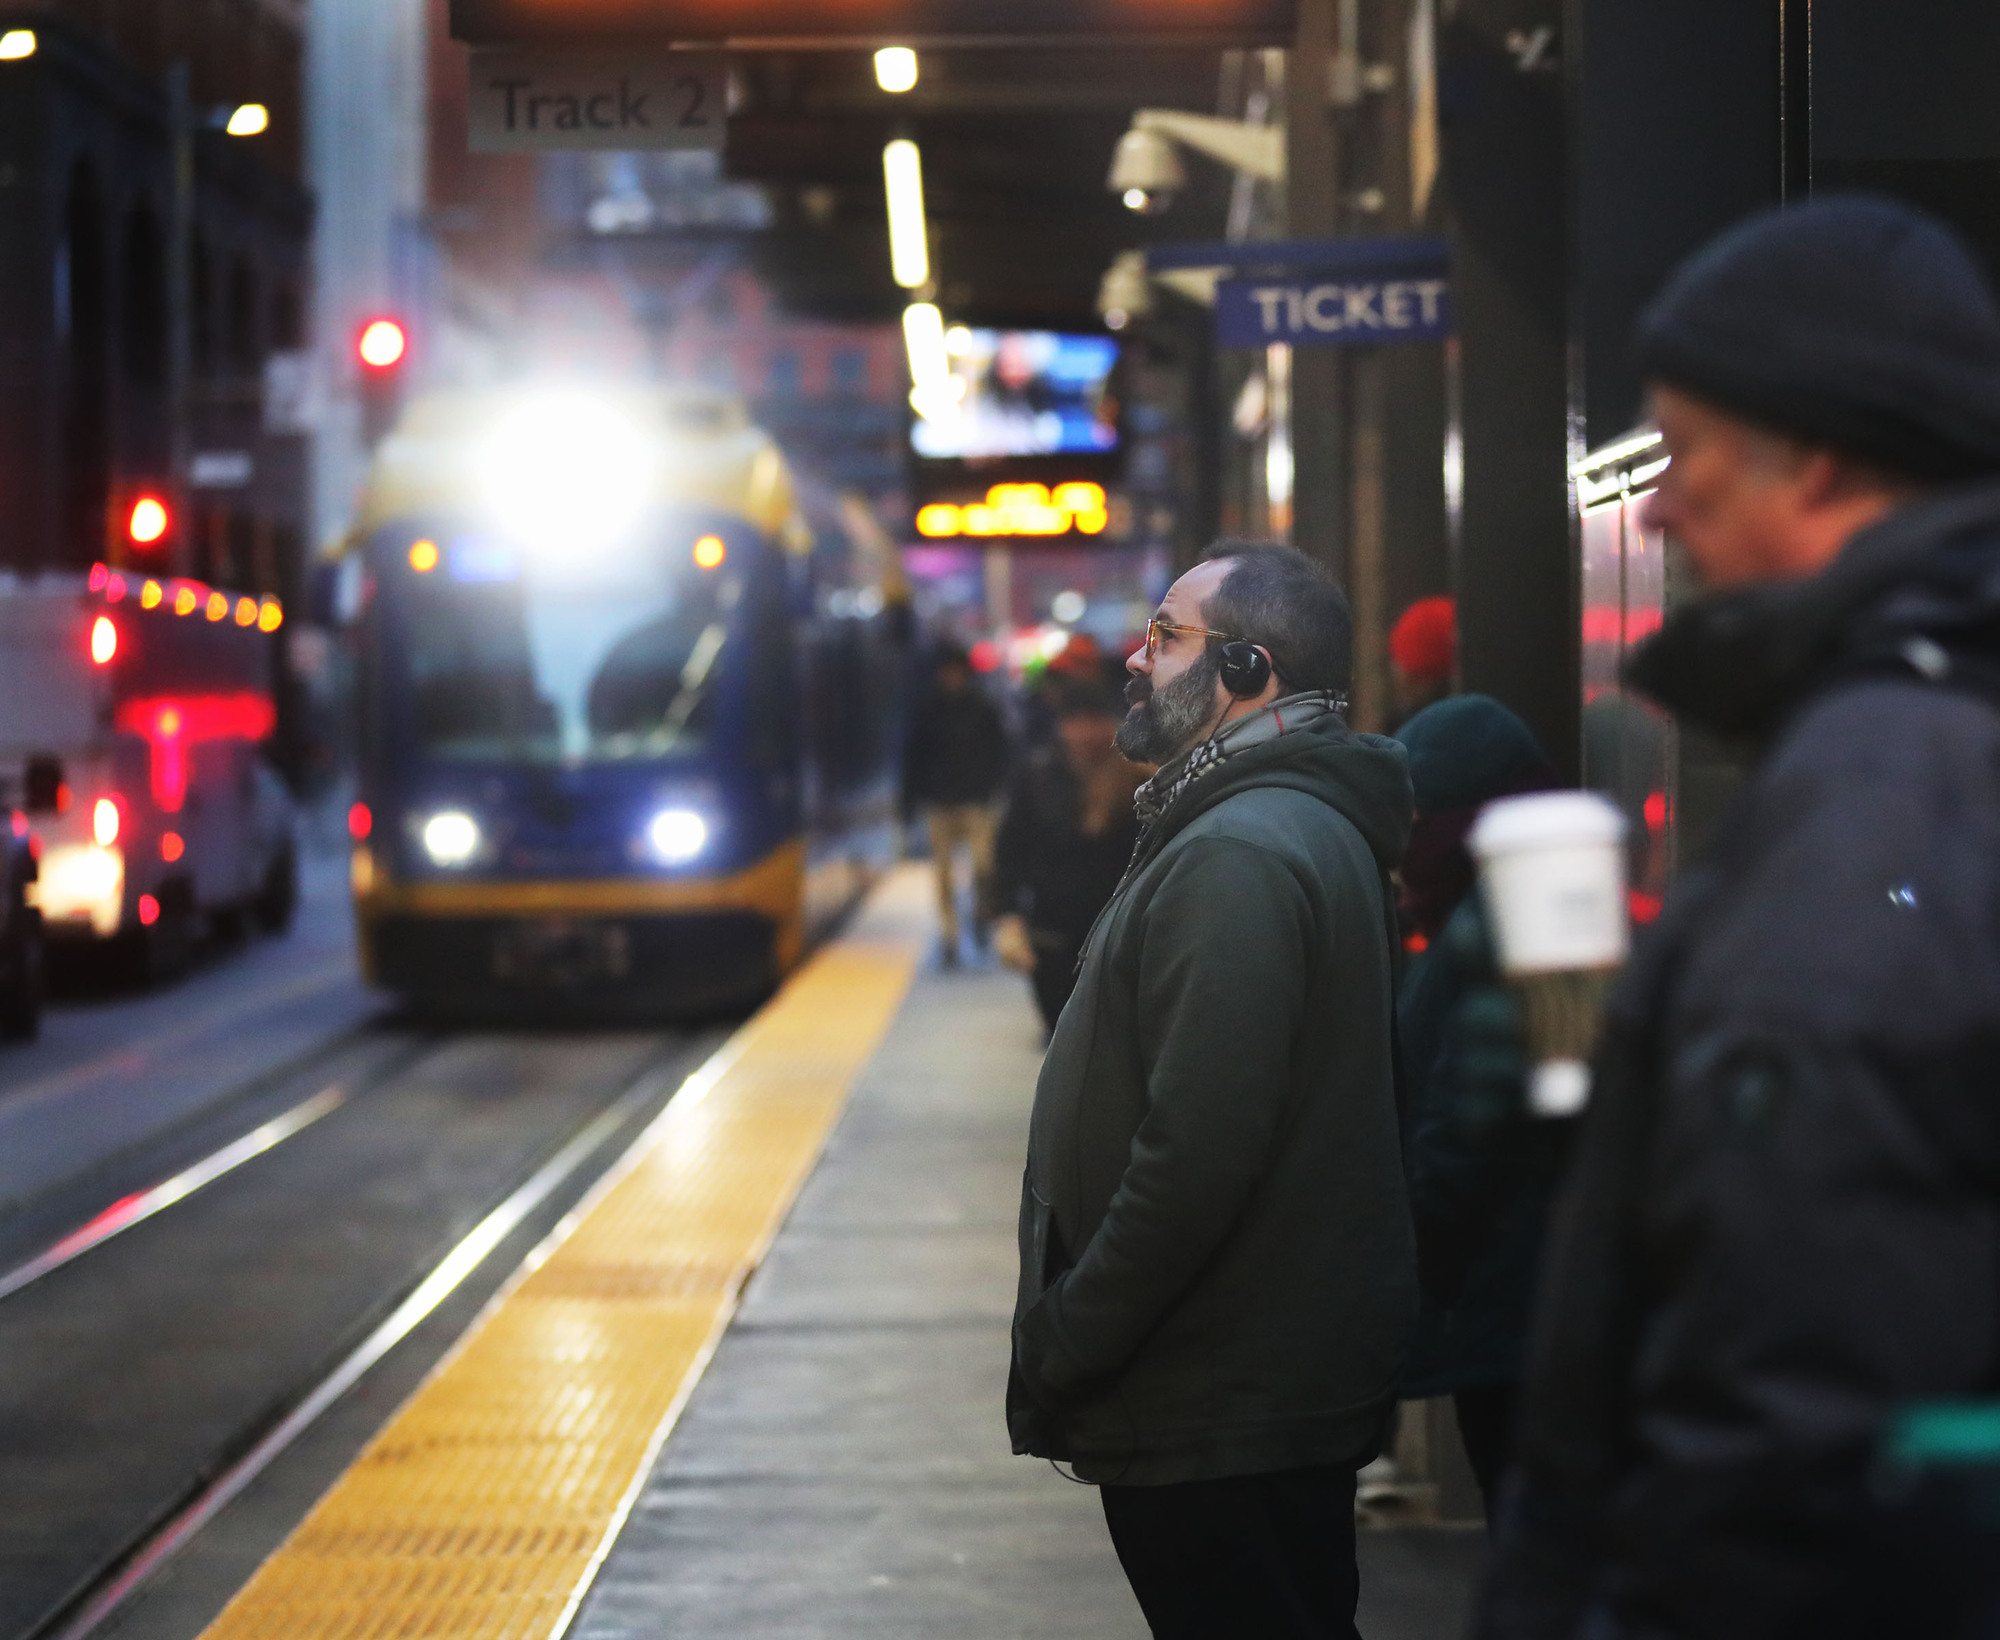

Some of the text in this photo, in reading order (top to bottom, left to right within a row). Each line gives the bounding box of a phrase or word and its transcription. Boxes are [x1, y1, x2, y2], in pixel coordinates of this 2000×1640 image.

[489, 73, 708, 131] Track 2
[1252, 280, 1445, 334] TICKET
